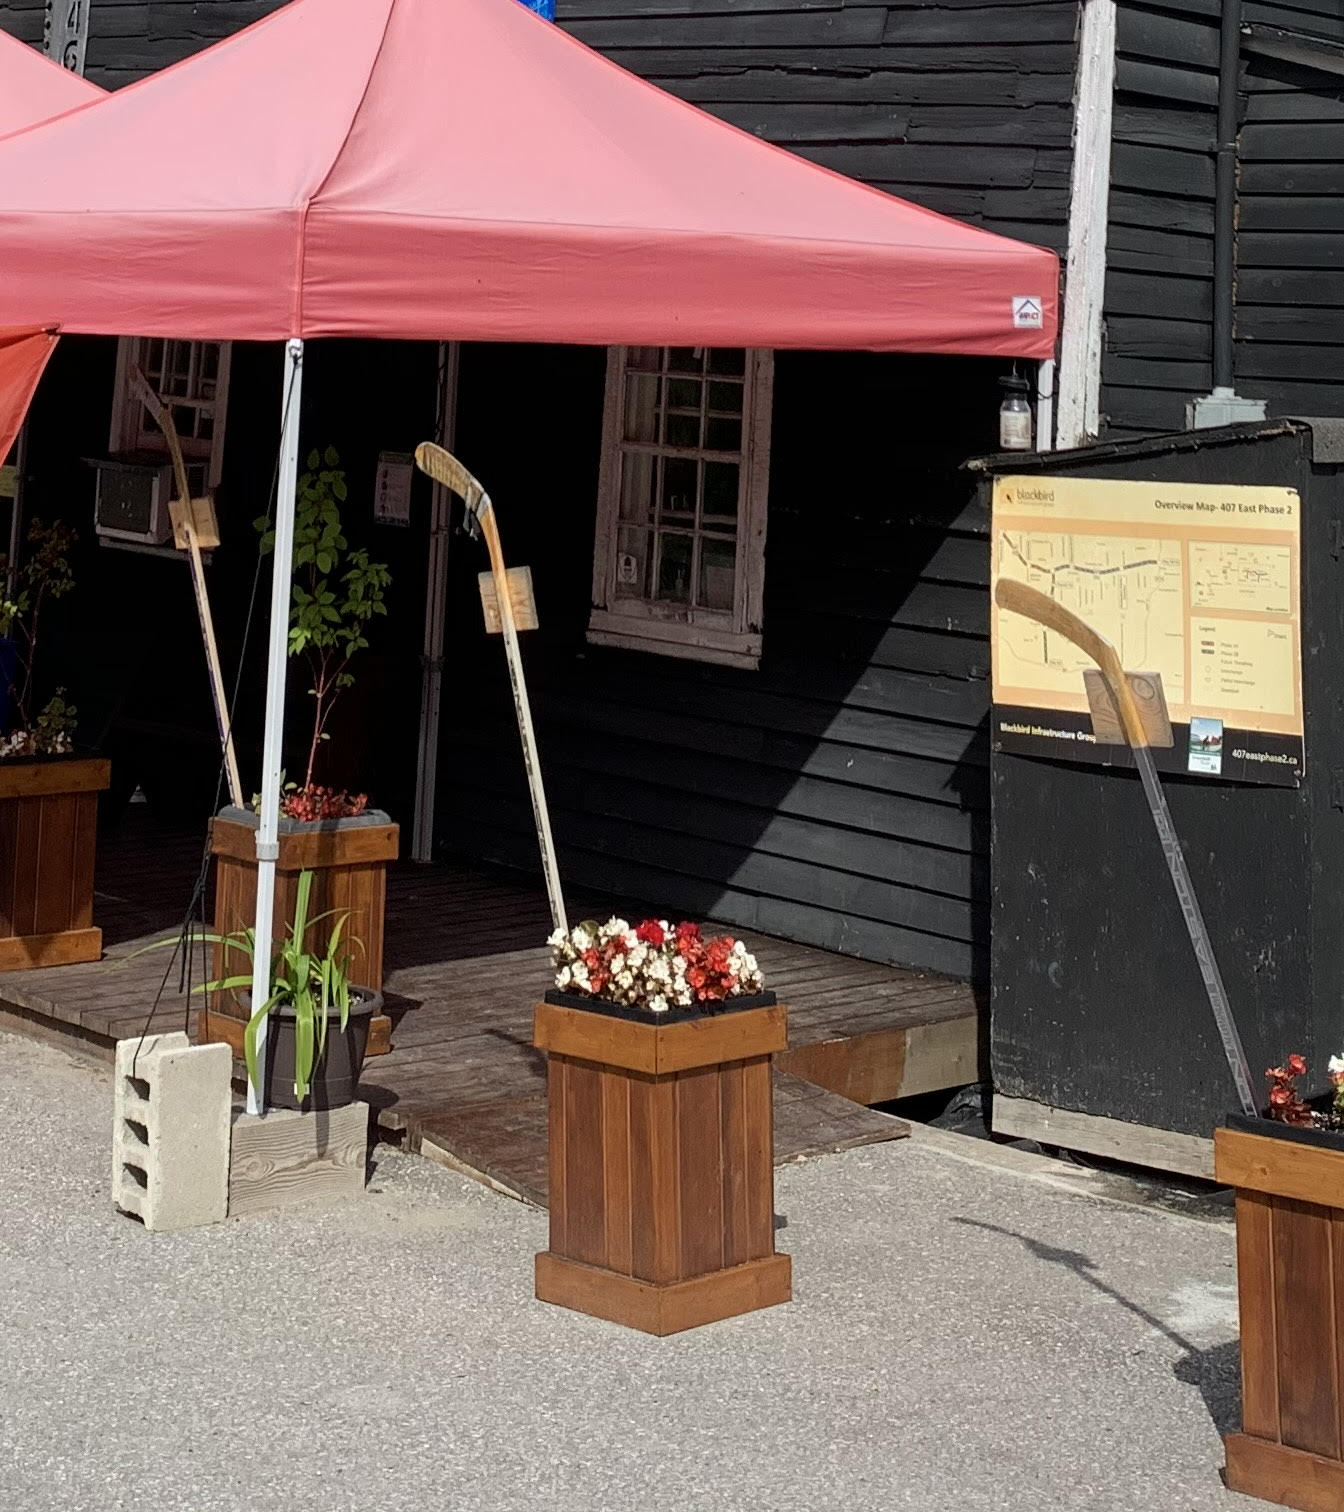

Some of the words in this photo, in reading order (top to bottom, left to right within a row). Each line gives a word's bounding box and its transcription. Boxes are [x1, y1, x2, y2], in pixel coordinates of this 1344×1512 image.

[1154, 499, 1194, 511] Overview
[1220, 503, 1236, 513] 407
[1238, 504, 1257, 514] East
[1258, 504, 1285, 515] Phase
[1286, 505, 1292, 515] 2
[1000, 722, 1031, 735] Blackbird
[1031, 726, 1076, 740] Infrastructure
[1232, 748, 1298, 765] 407eastphase2.ca
